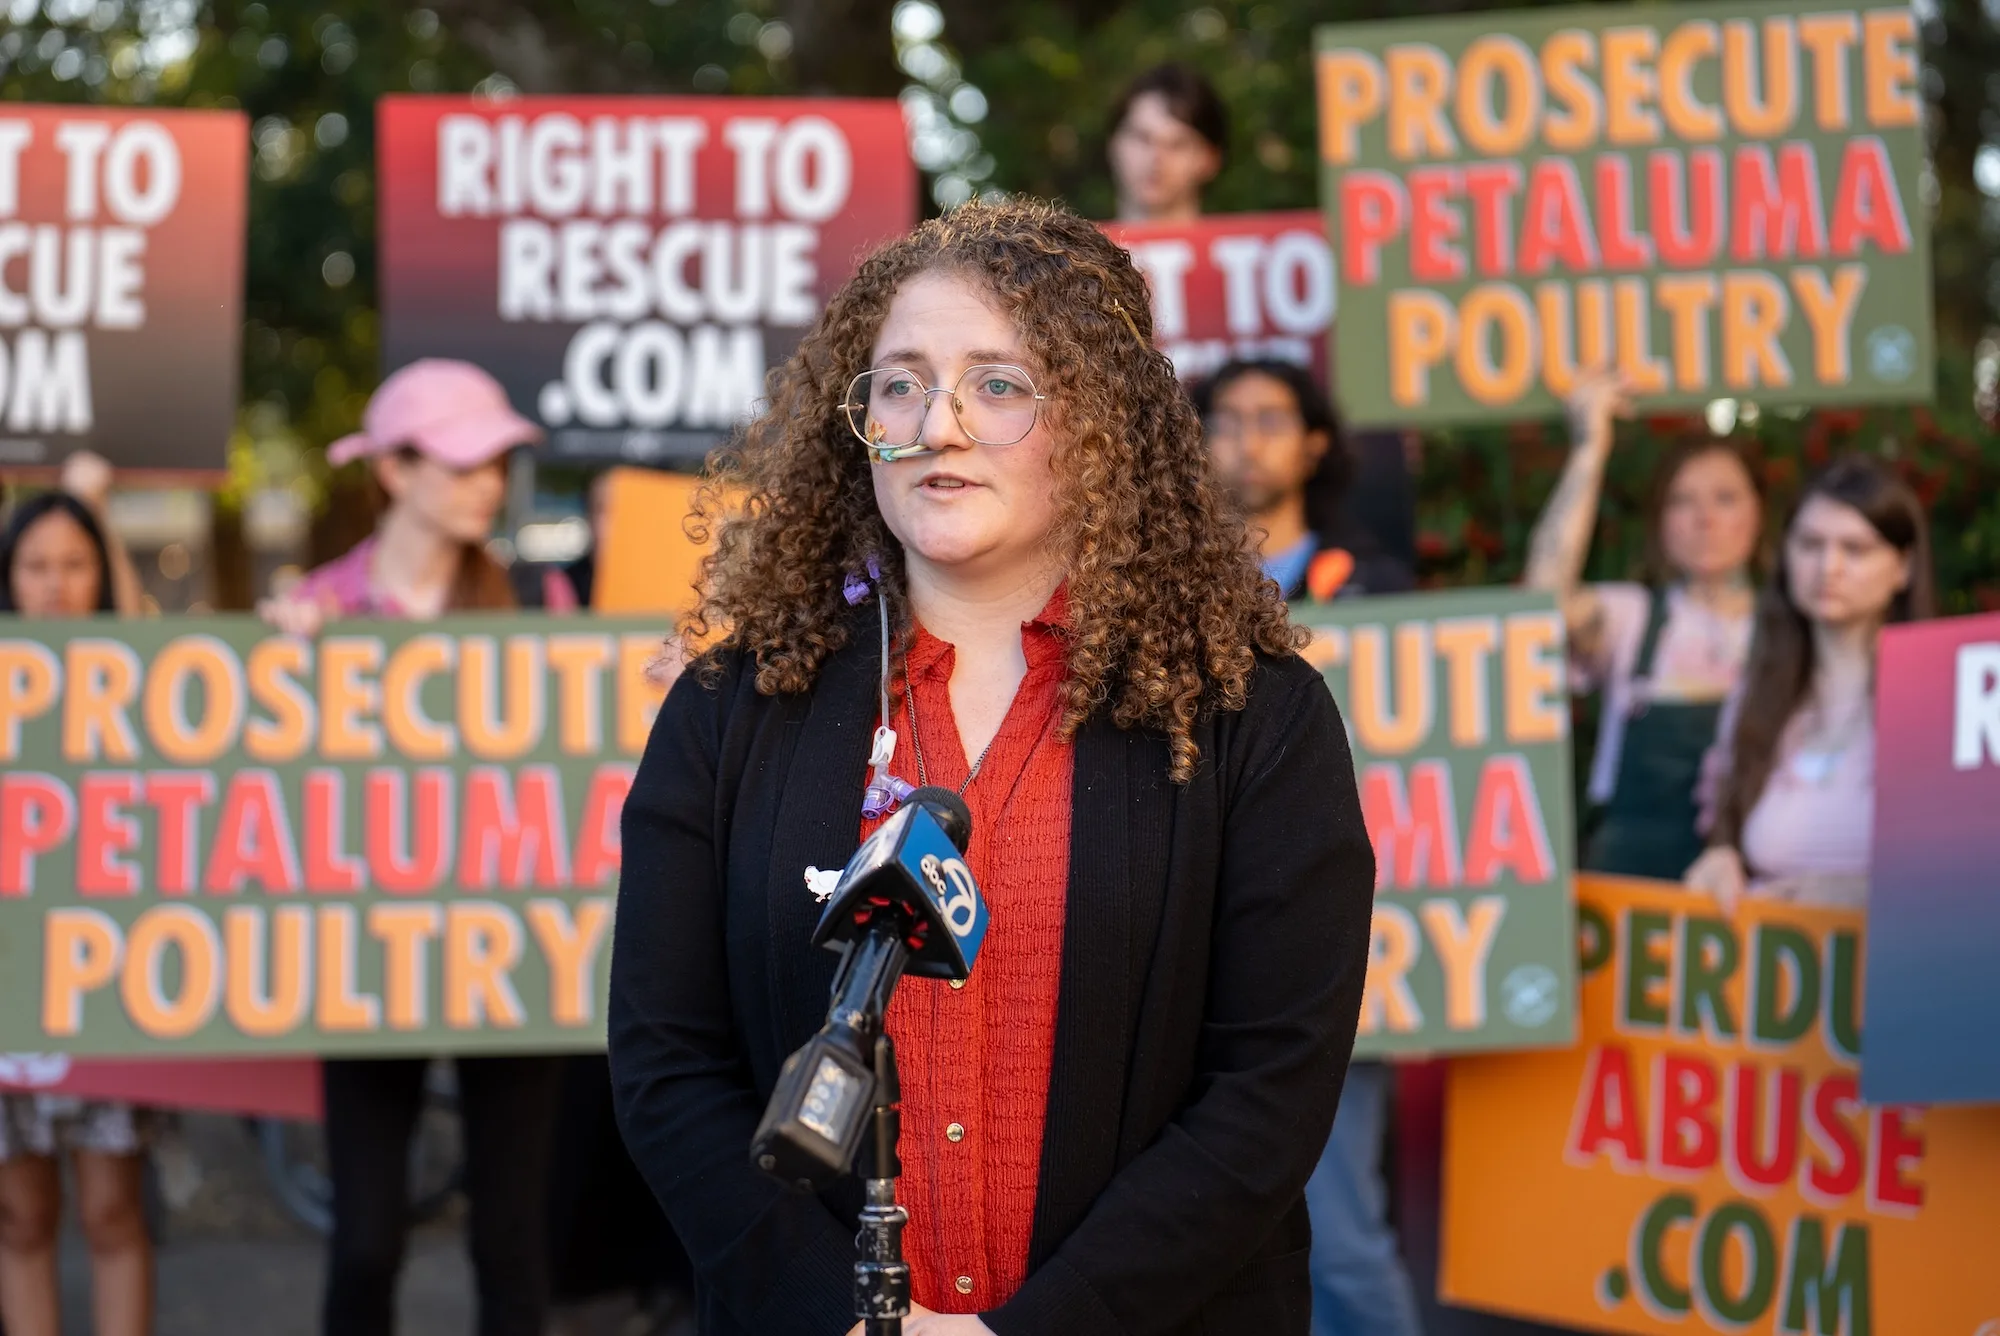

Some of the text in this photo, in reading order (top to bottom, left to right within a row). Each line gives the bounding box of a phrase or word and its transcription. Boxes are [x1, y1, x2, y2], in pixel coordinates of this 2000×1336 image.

[1318, 9, 1920, 166] PROSECUTE
[55, 119, 182, 224] TO
[436, 114, 851, 222] RIGHT TO
[1338, 135, 1913, 286] PETALUMA
[500, 220, 819, 326] RESCUE
[1210, 229, 1337, 335] TO
[1388, 263, 1867, 407] POULTRY
[0, 325, 93, 434] M
[538, 321, 768, 430] .COM
[1298, 610, 1569, 756] UTE
[920, 857, 947, 896] abc
[41, 899, 613, 1039] POULTRY
[1358, 894, 1508, 1036] RY
[1562, 1044, 1927, 1219] ABUSE
[1595, 1191, 1870, 1336] .COM
